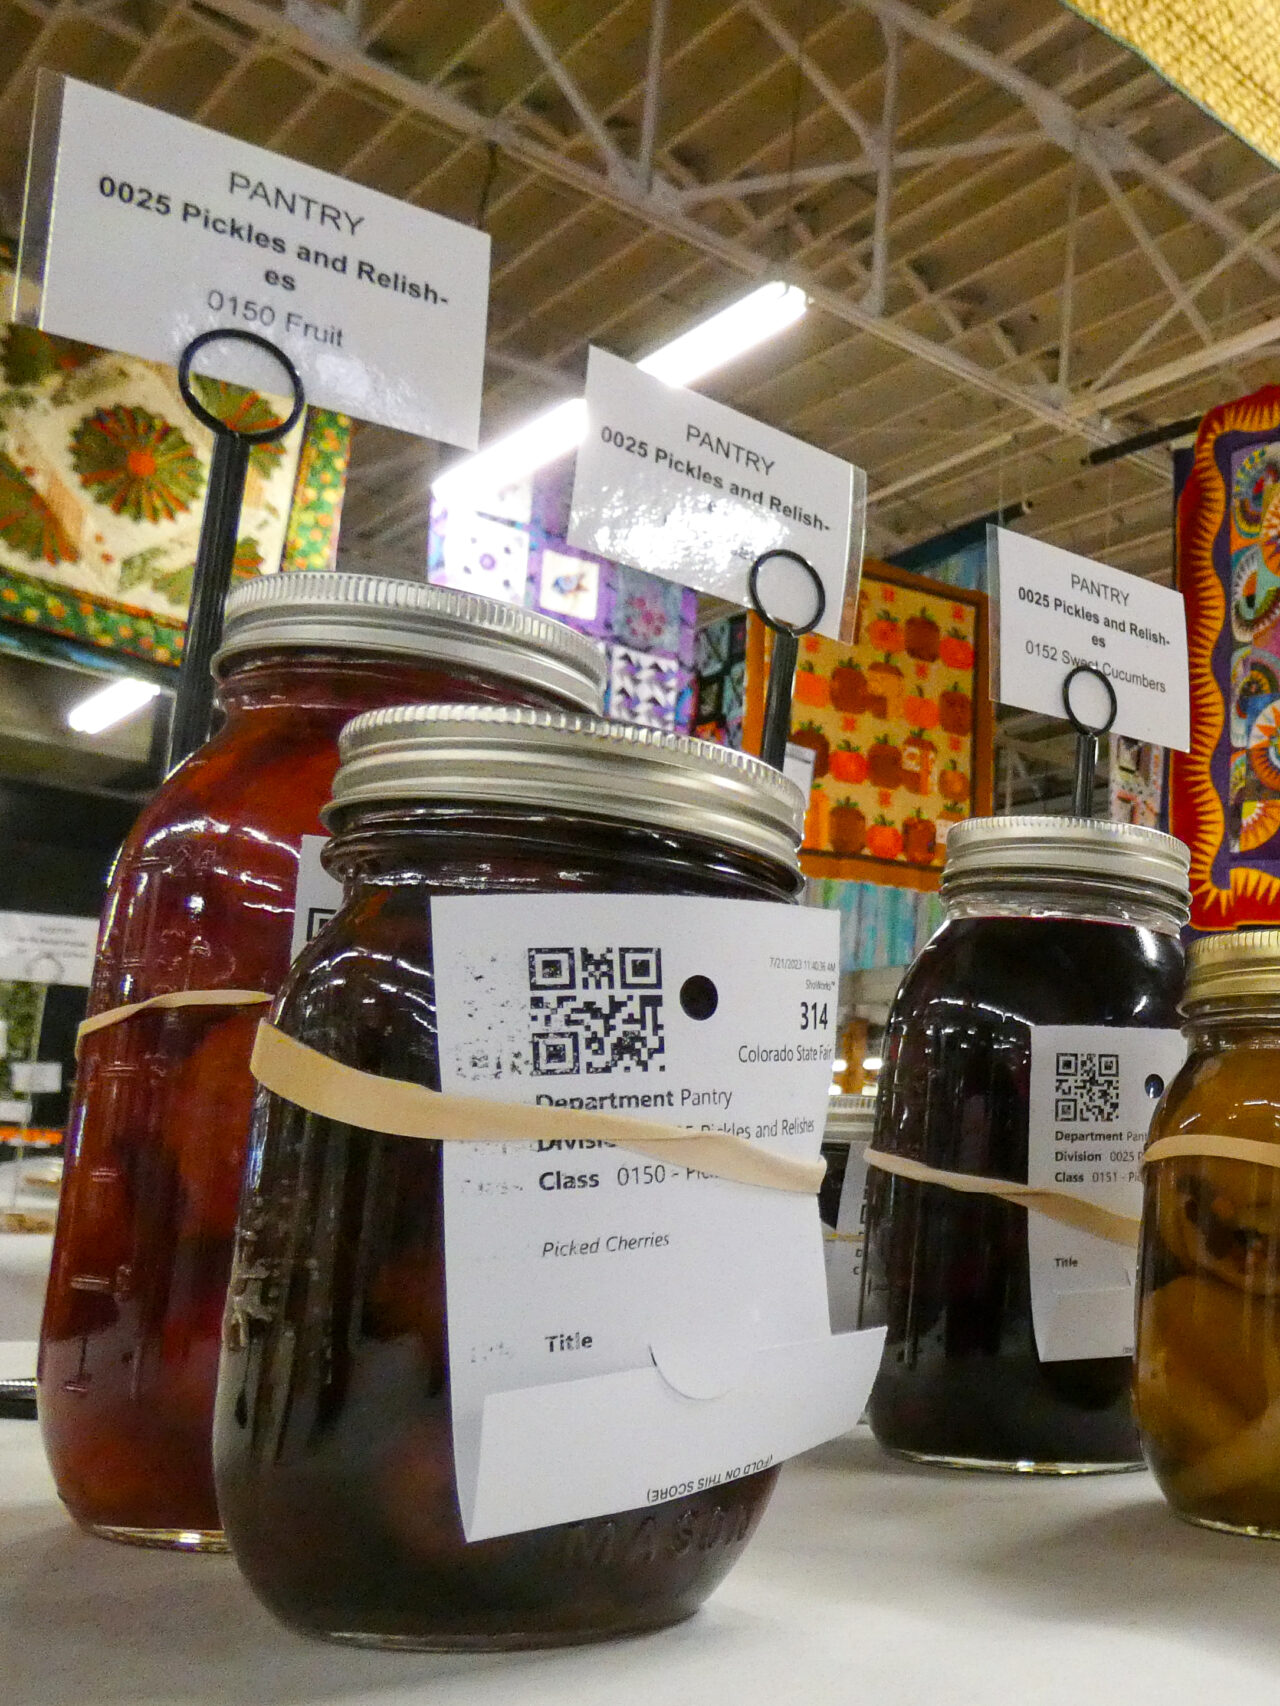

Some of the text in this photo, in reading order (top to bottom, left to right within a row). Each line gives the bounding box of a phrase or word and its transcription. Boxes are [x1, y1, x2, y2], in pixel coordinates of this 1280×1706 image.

[229, 170, 366, 237] PANTRY
[99, 174, 449, 305] 0025 Pickles and Relish-
[264, 266, 296, 291] es
[206, 288, 344, 348] 0150 Fruit
[686, 423, 775, 477] PANTRY
[601, 426, 831, 532] 0025 Pickles and Relish-
[1071, 573, 1130, 607] PANTRY
[1018, 586, 1171, 646] 0025 Pickles and Relish-
[1091, 634, 1106, 648] es
[1025, 640, 1058, 662] 0152
[1102, 662, 1167, 693] Cucumbers
[800, 1001, 829, 1031] 314
[738, 1043, 832, 1063] Colorado State Fair
[535, 1089, 733, 1111] Department Pantry
[755, 1121, 778, 1139] and
[781, 1116, 815, 1136] Relishes
[1055, 1130, 1123, 1144] Department
[1055, 1150, 1102, 1162] Division
[1109, 1151, 1135, 1162] 0025
[538, 1170, 600, 1192] Class
[616, 1164, 666, 1187] 0150
[1054, 1171, 1085, 1183] Class
[1092, 1171, 1117, 1183] 0151
[542, 1231, 671, 1259] Picked Cherries
[1055, 1257, 1078, 1268] Title
[545, 1332, 594, 1355] Title
[697, 1473, 722, 1490] THIS
[725, 1467, 741, 1480] ON
[646, 1481, 695, 1504] SCORE)
